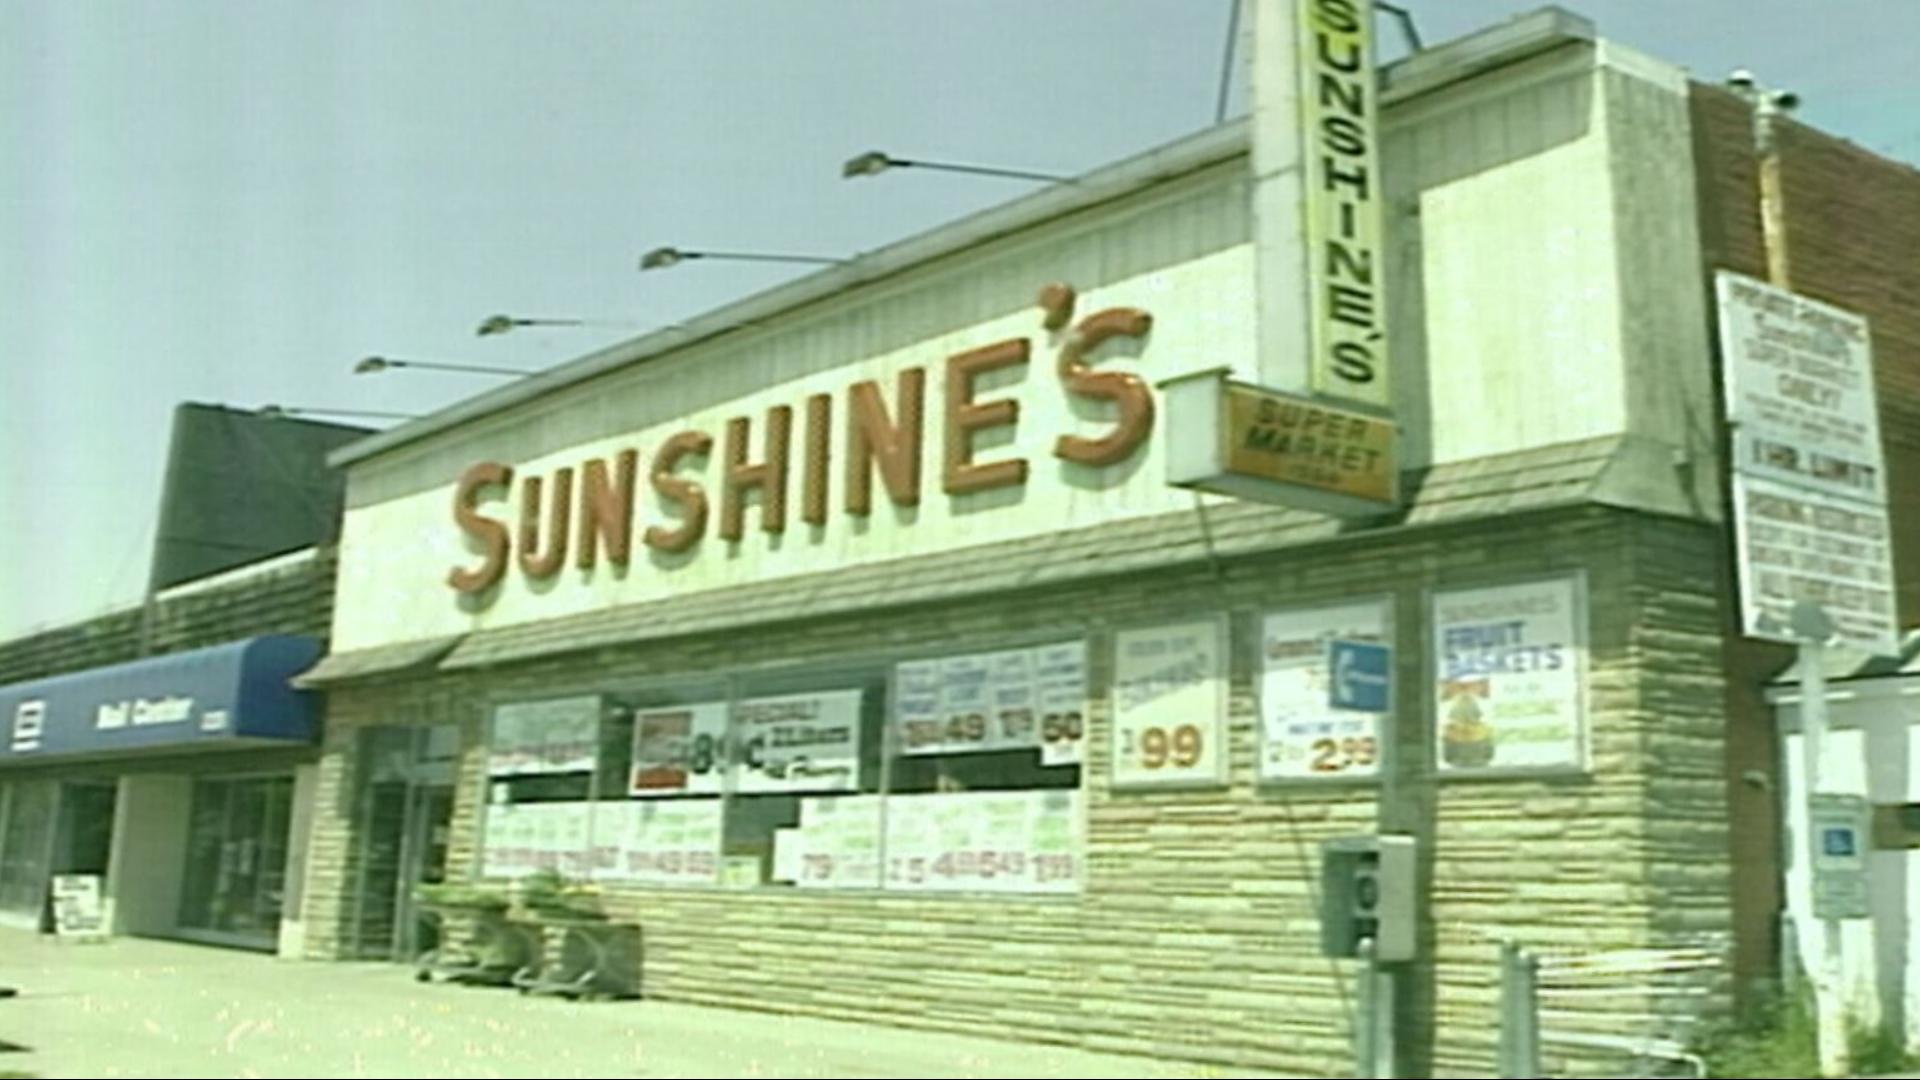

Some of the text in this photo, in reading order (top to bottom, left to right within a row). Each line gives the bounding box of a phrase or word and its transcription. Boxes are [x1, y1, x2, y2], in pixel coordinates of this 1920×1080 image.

[1316, 0, 1383, 384] SUNSHINE'S
[448, 282, 1156, 595] SUNSHINE'S
[1258, 397, 1367, 441] SUPER
[1244, 426, 1380, 471] MARKET
[1143, 724, 1204, 770] 99
